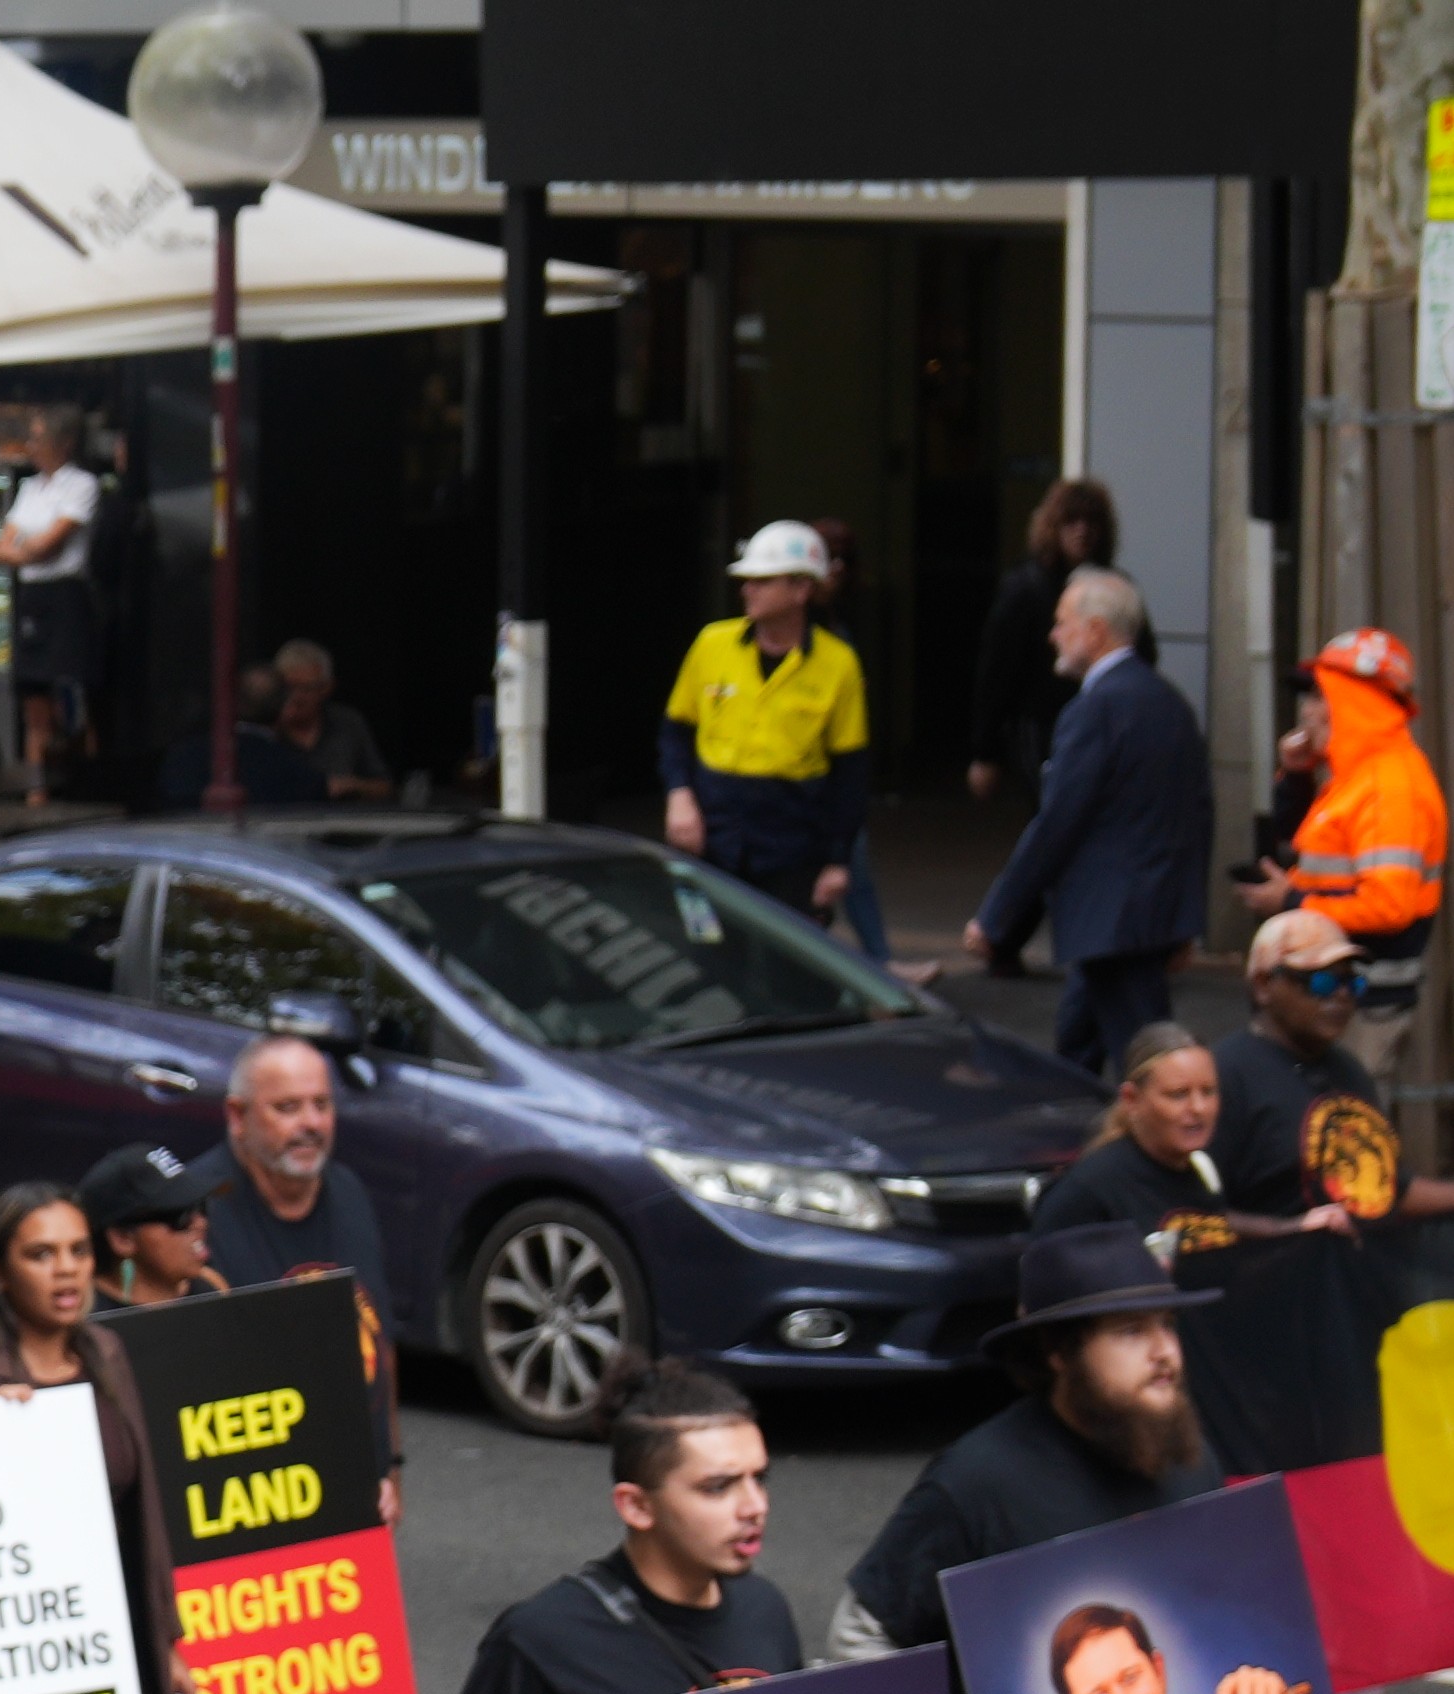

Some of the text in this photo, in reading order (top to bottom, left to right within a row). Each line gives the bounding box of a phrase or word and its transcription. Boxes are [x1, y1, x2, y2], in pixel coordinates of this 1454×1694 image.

[179, 1387, 306, 1462] KEEP
[186, 1464, 322, 1539] LAND
[177, 1559, 361, 1645] RIGHTS
